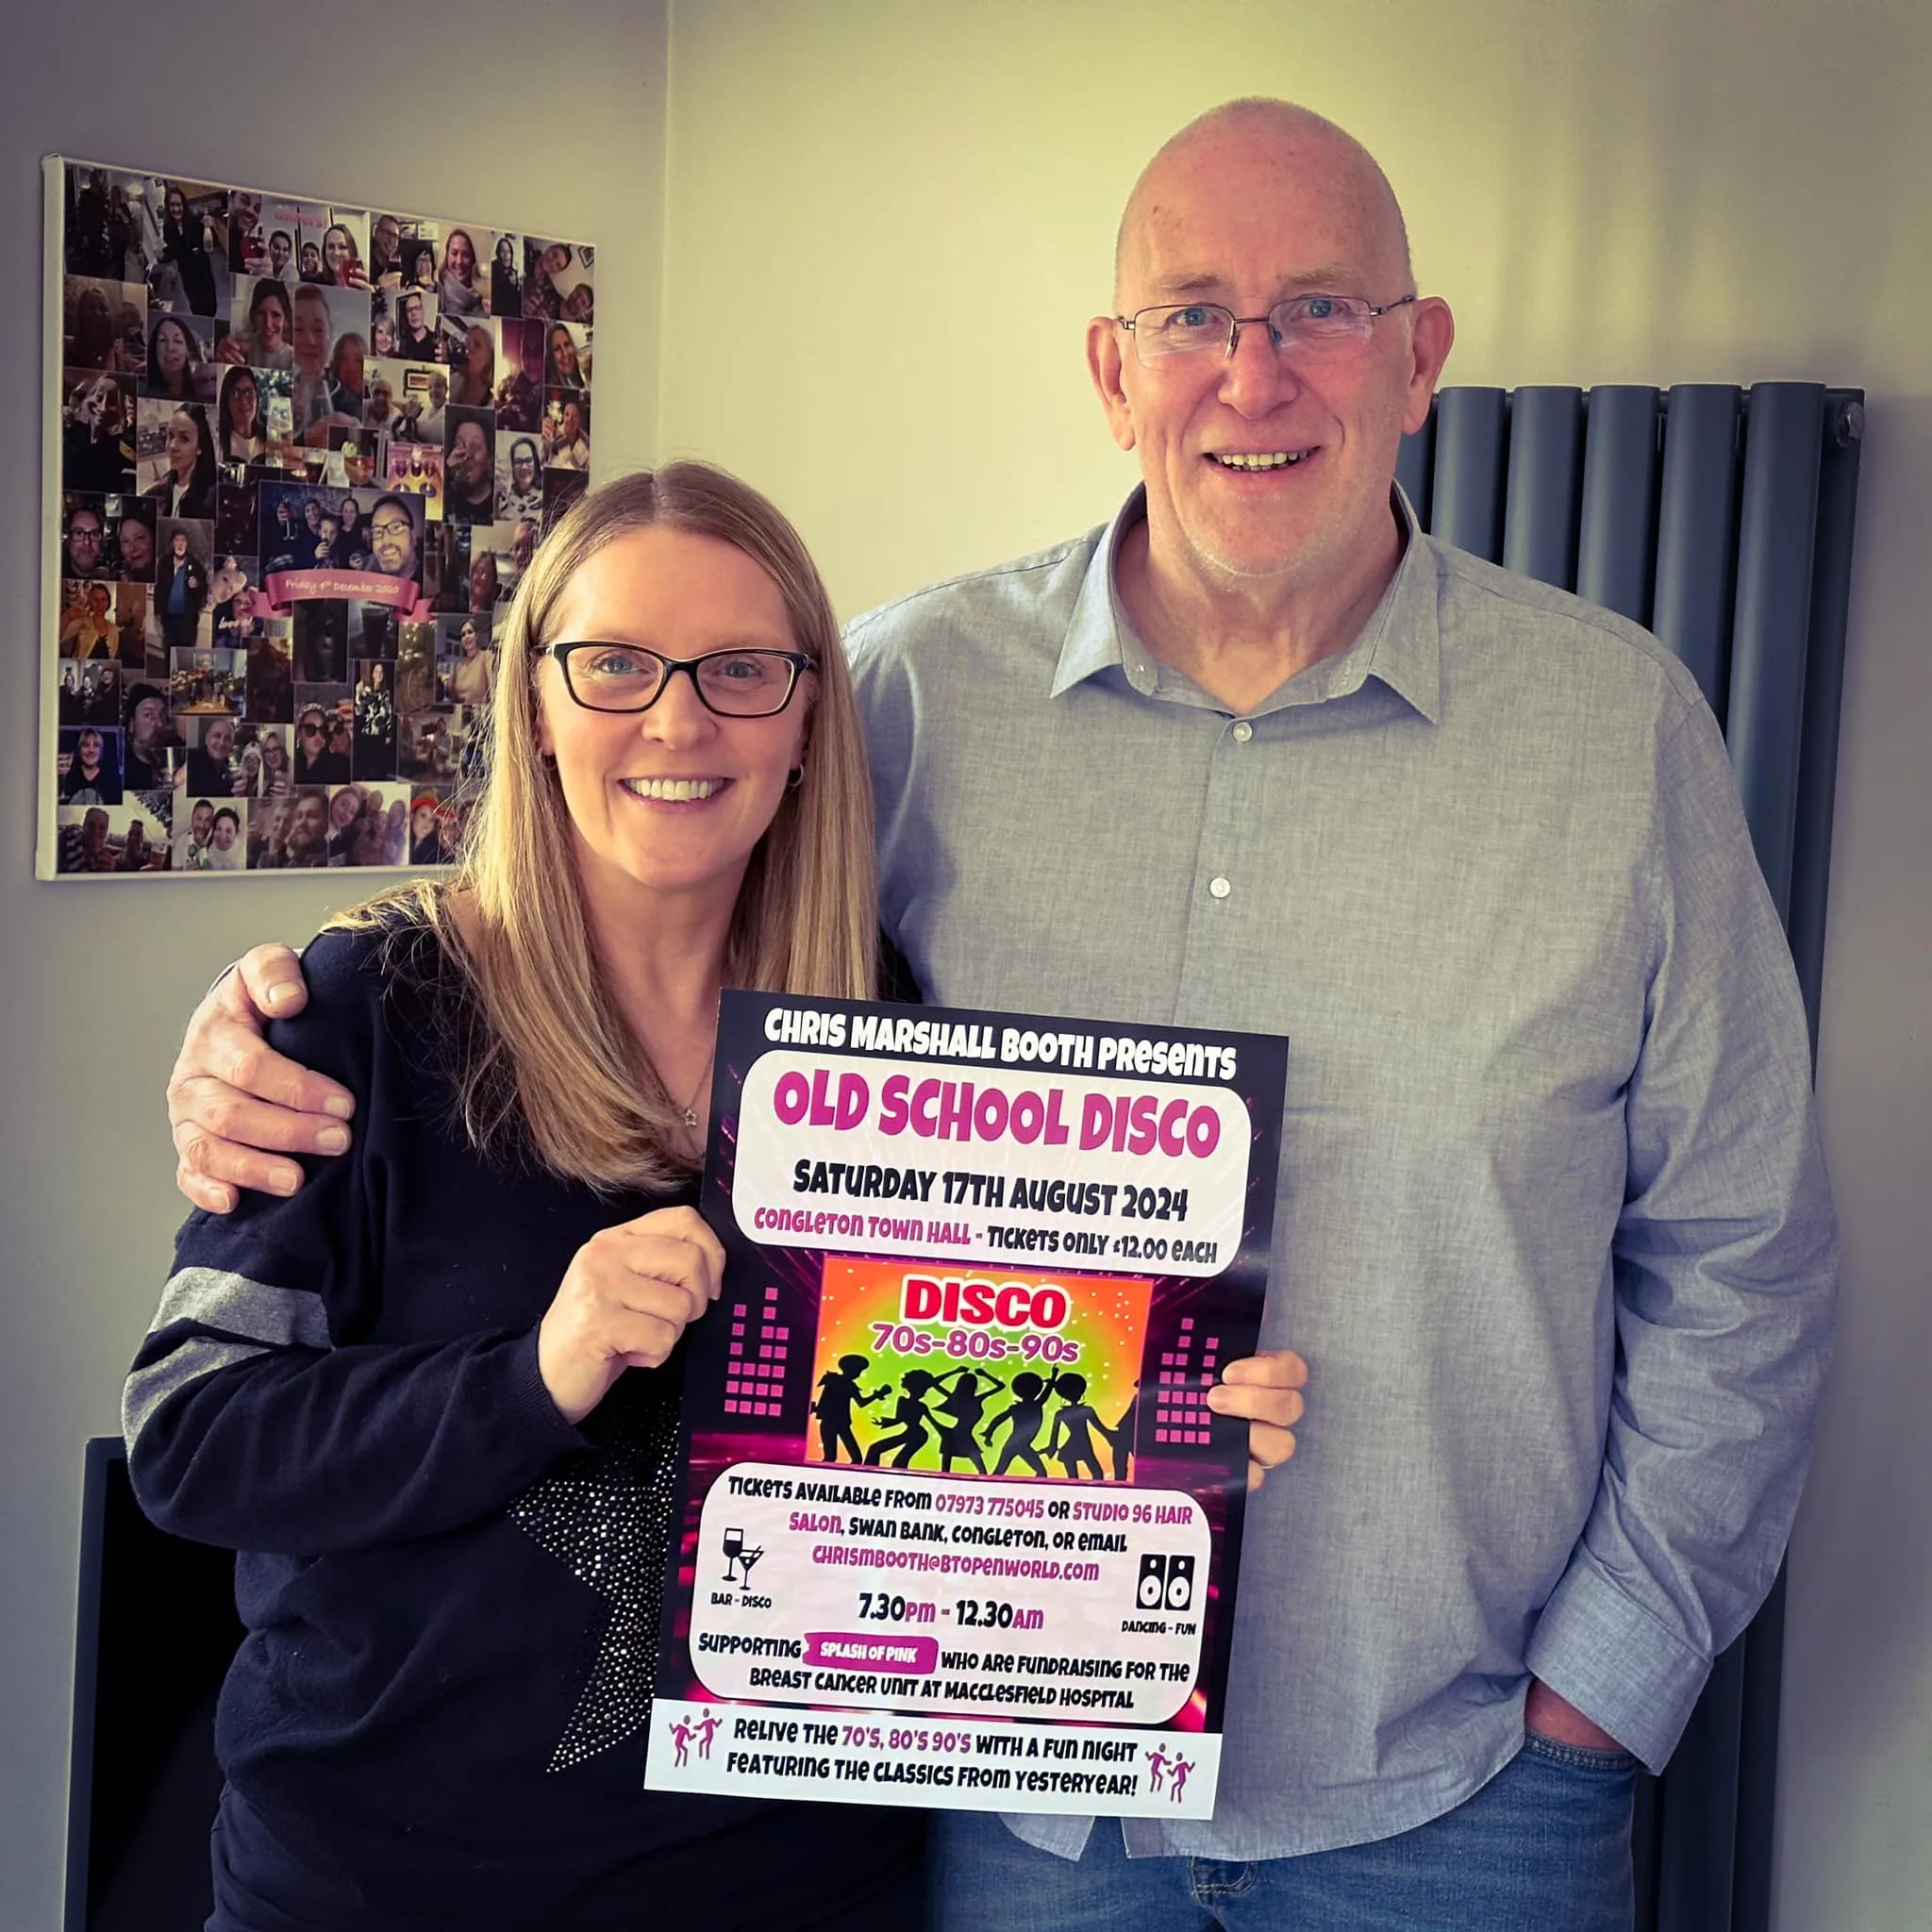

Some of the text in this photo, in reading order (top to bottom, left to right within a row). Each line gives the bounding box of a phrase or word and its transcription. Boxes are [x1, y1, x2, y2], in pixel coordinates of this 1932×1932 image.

[286, 579, 316, 594] Friday
[333, 581, 374, 593] December
[764, 1008, 846, 1047] CHRIS
[851, 1015, 996, 1059] MARSHALL
[1001, 1027, 1093, 1068] BOOTH
[774, 1068, 1221, 1158] OLD SCHOOL DISCO
[793, 1158, 1189, 1222] SATURDAY 17TH AUGUST 2024
[926, 1222, 971, 1245] HALL
[1112, 1236, 1168, 1259] £12.00
[903, 1277, 1068, 1330] DISCO
[872, 1323, 1080, 1363] 70s-80s-90s
[936, 1493, 984, 1516] 07973
[988, 1497, 1044, 1519] 775045
[1048, 1501, 1070, 1520] OR
[1073, 1501, 1128, 1523] STUDIO
[1132, 1504, 1152, 1524] 96
[1155, 1505, 1192, 1525] HAIR
[1052, 1531, 1074, 1550] OR
[710, 1592, 733, 1606] BAR
[741, 1595, 772, 1609] DISCO
[1174, 1623, 1196, 1635] FUN
[820, 1641, 867, 1659] SPLASH
[868, 1646, 885, 1660] OF
[884, 1648, 919, 1663] PINK
[941, 1652, 979, 1671] WHO
[1125, 1661, 1156, 1680] FOR
[920, 1680, 942, 1699] AT
[1059, 1689, 1135, 1709] HOSPITAL
[842, 1725, 884, 1752] 70'S,
[888, 1729, 928, 1751] 80'S
[932, 1731, 971, 1753] 90'S
[975, 1735, 1023, 1757] WITH
[1026, 1738, 1039, 1757] A
[874, 1761, 954, 1786] CLASSICS
